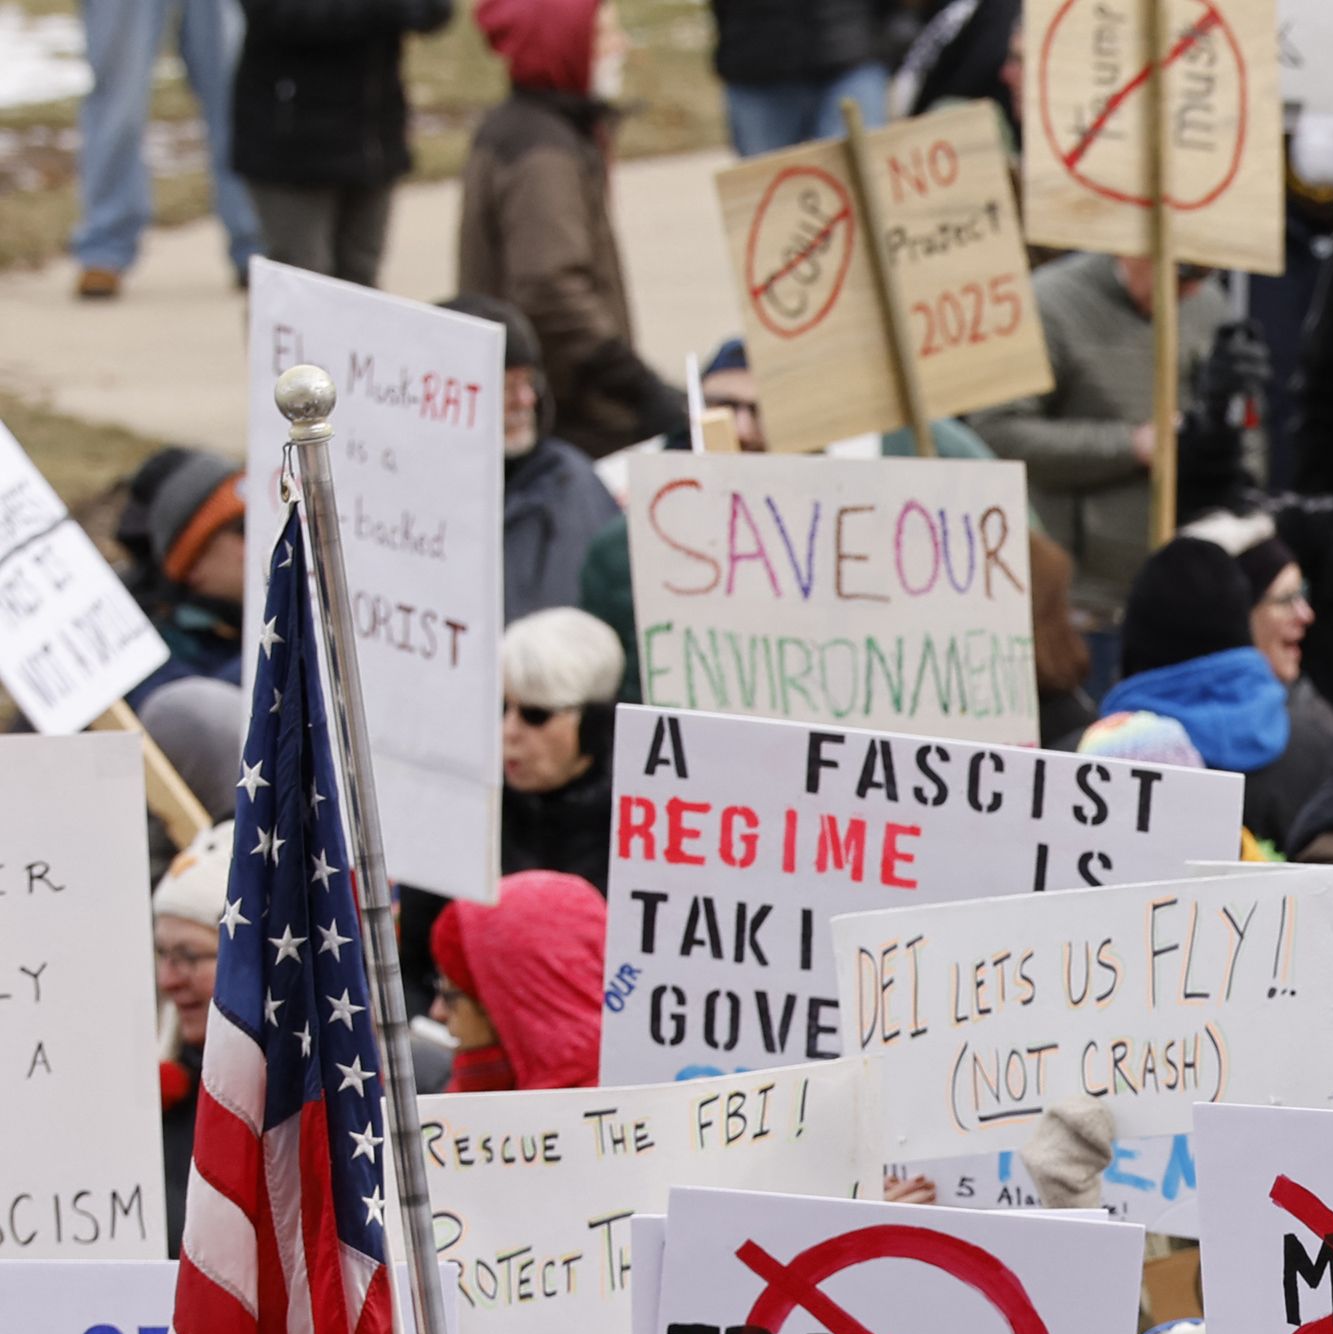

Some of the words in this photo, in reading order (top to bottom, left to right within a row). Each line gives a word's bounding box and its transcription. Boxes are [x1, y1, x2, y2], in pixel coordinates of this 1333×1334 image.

[887, 141, 959, 206] NO
[910, 275, 1023, 359] 2025
[649, 479, 891, 602] SAVE
[894, 499, 1025, 600] OUR
[642, 620, 1038, 721] ENVIRONMENT
[644, 715, 689, 779] A
[805, 731, 1163, 833] FASCIST
[617, 795, 922, 889] REGIME
[856, 934, 928, 1049] DEI
[950, 951, 1037, 1025] LETS
[1065, 937, 1123, 1008] US
[584, 1108, 655, 1157] THE
[955, 1177, 976, 1198] 5
